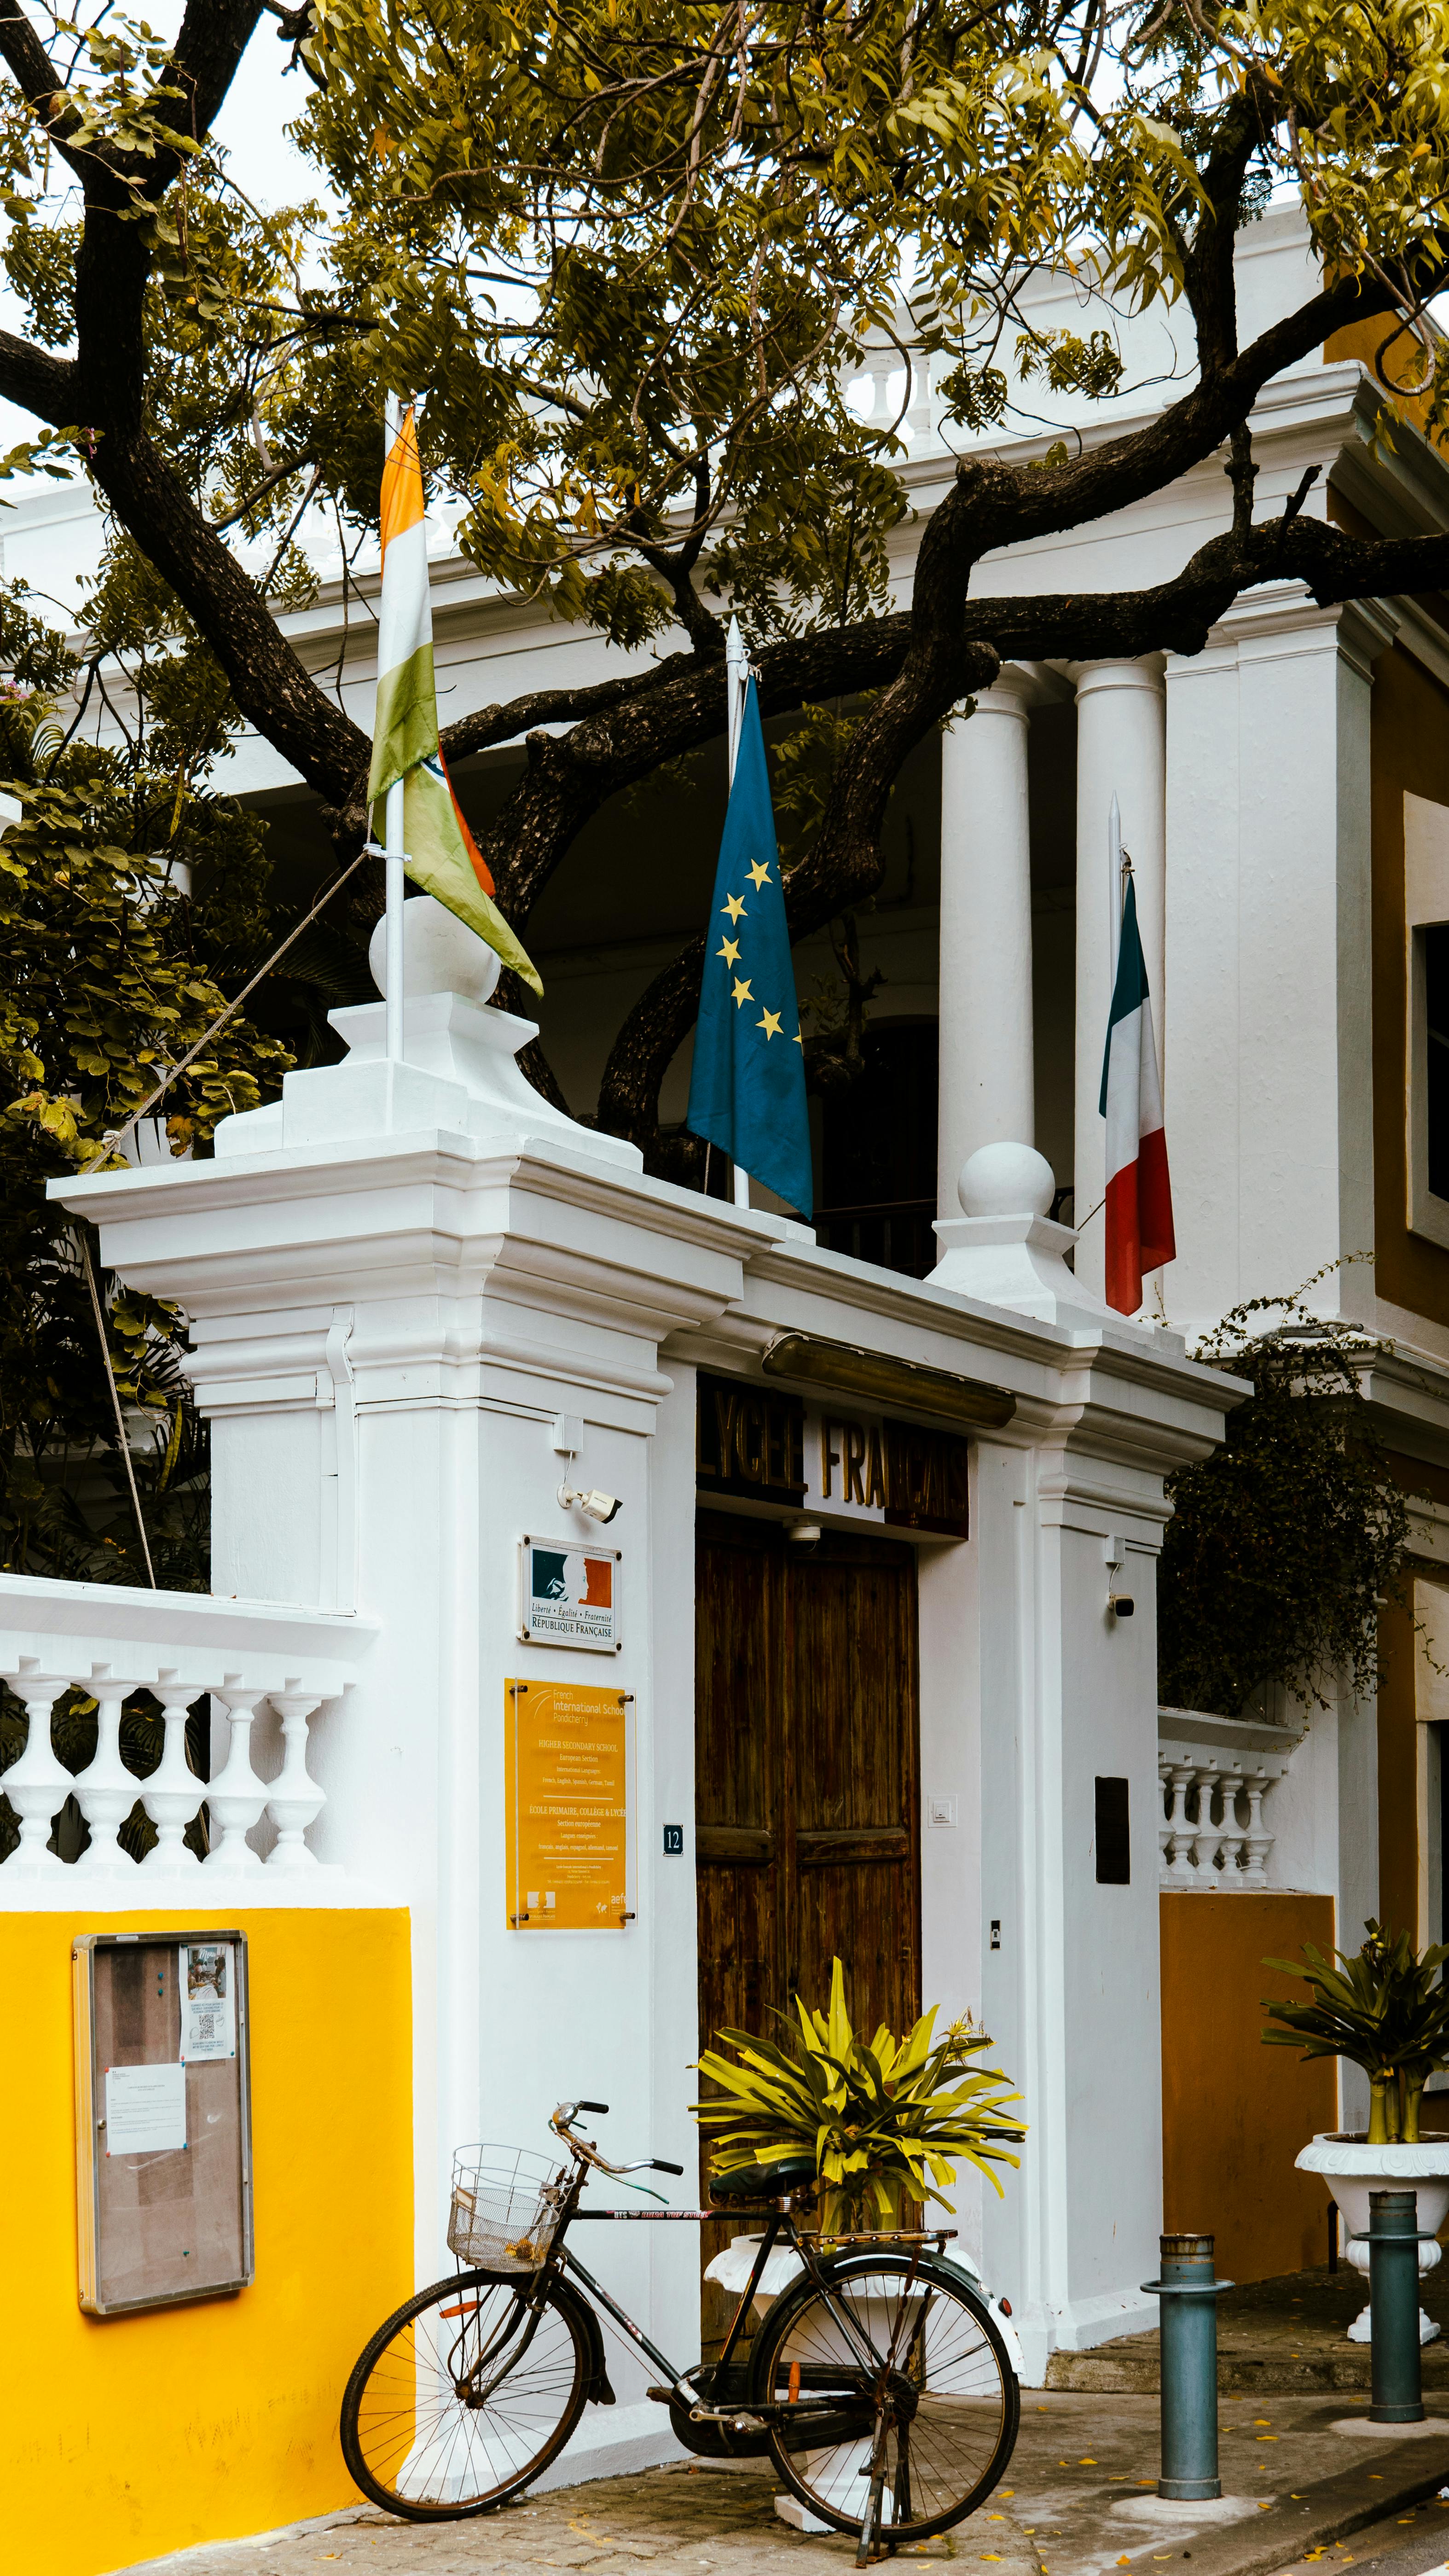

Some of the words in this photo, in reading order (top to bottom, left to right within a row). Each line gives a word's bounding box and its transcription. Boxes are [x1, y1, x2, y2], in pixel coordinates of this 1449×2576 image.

[696, 1385, 809, 1493] LYCÉE
[532, 1603, 551, 1613] Liberté
[558, 1605, 578, 1618] Égalité
[585, 1611, 612, 1622] Fraternité
[532, 1616, 574, 1633] RÉPUBLIQUE
[576, 1623, 612, 1637] FRANÇAISE
[553, 1689, 573, 1700] French
[553, 1700, 601, 1714] International
[603, 1704, 626, 1716] School
[553, 1712, 588, 1726] Pondicherry
[539, 1739, 562, 1749] HIGHER
[562, 1741, 596, 1751] SECONDARY
[596, 1743, 618, 1752] SCHOOL
[560, 1753, 581, 1762] European
[530, 1804, 547, 1814] ÉCOLE
[549, 1806, 579, 1817] PRIMAIRE,
[580, 1807, 604, 1816] COLLÈGE
[605, 1808, 609, 1816] &
[575, 1820, 601, 1829] européenne
[667, 1831, 680, 1849] 12
[199, 1948, 217, 1961] Menu
